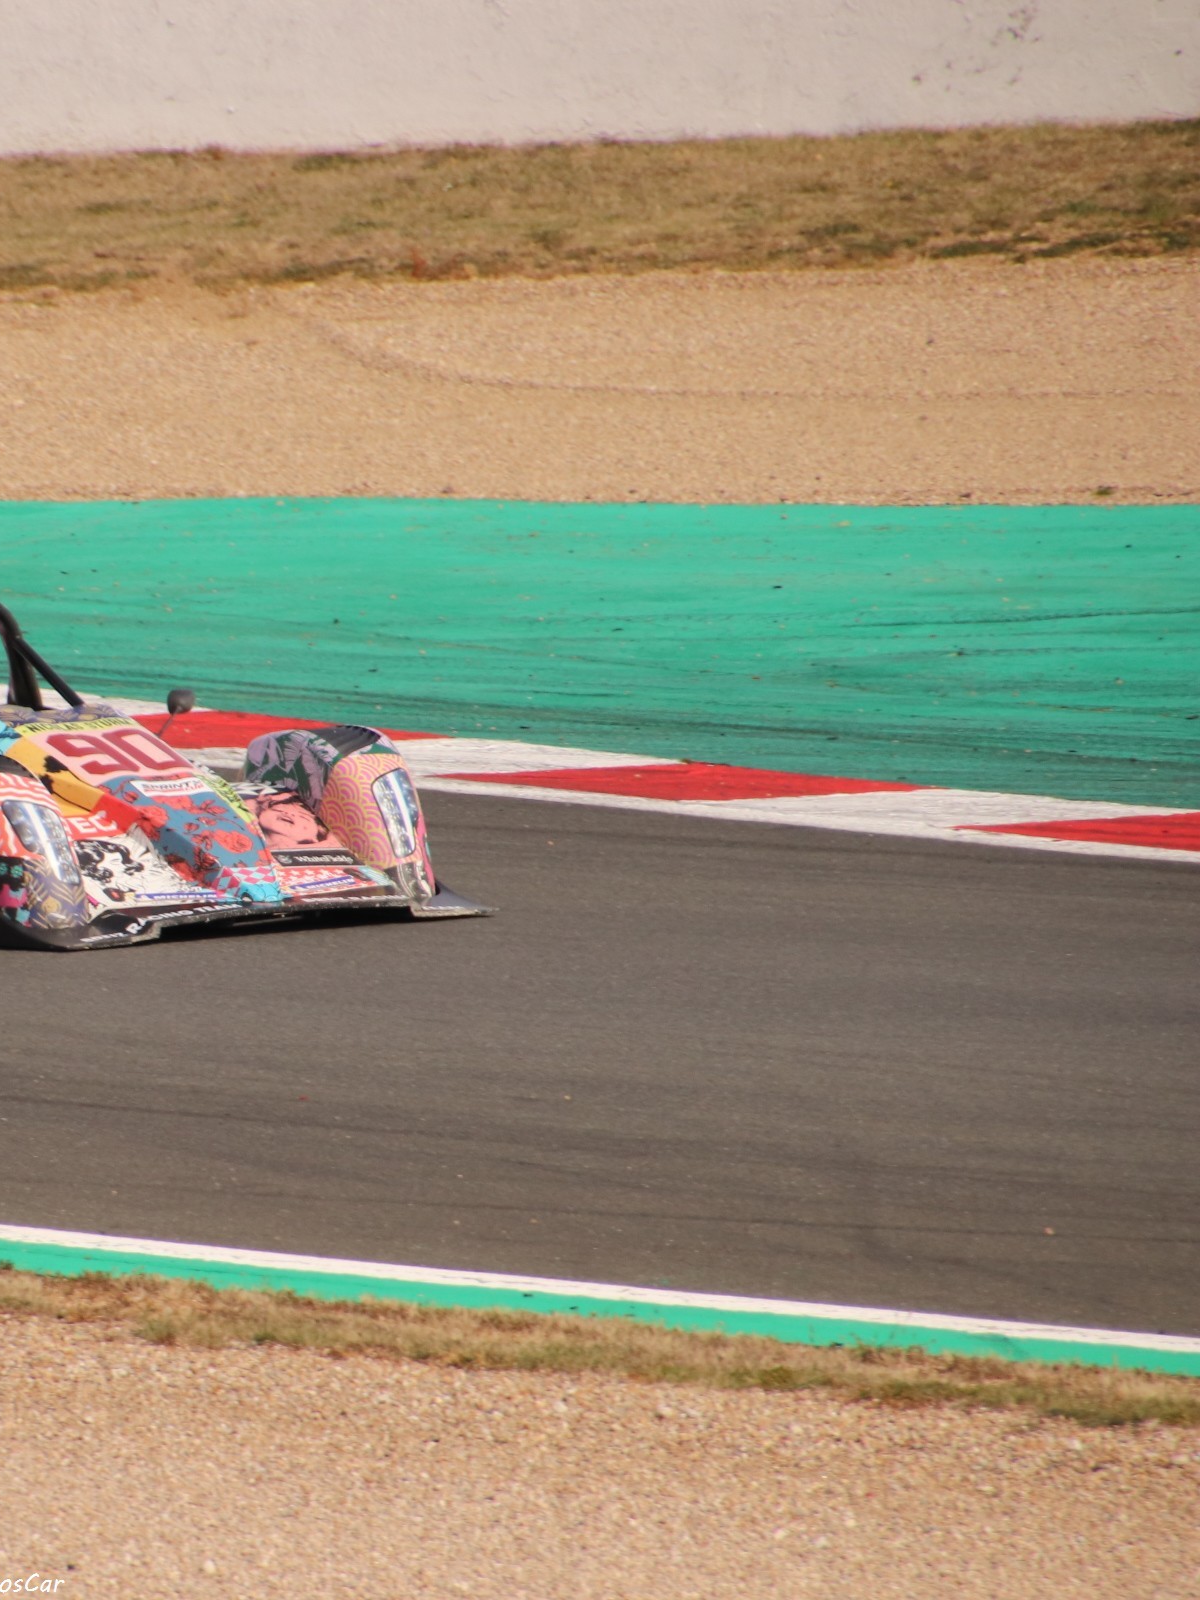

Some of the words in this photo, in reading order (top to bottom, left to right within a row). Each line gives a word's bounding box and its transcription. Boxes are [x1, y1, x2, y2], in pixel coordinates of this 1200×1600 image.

[46, 728, 195, 775] 90
[125, 909, 193, 935] RACING
[194, 903, 244, 914] TEAM
